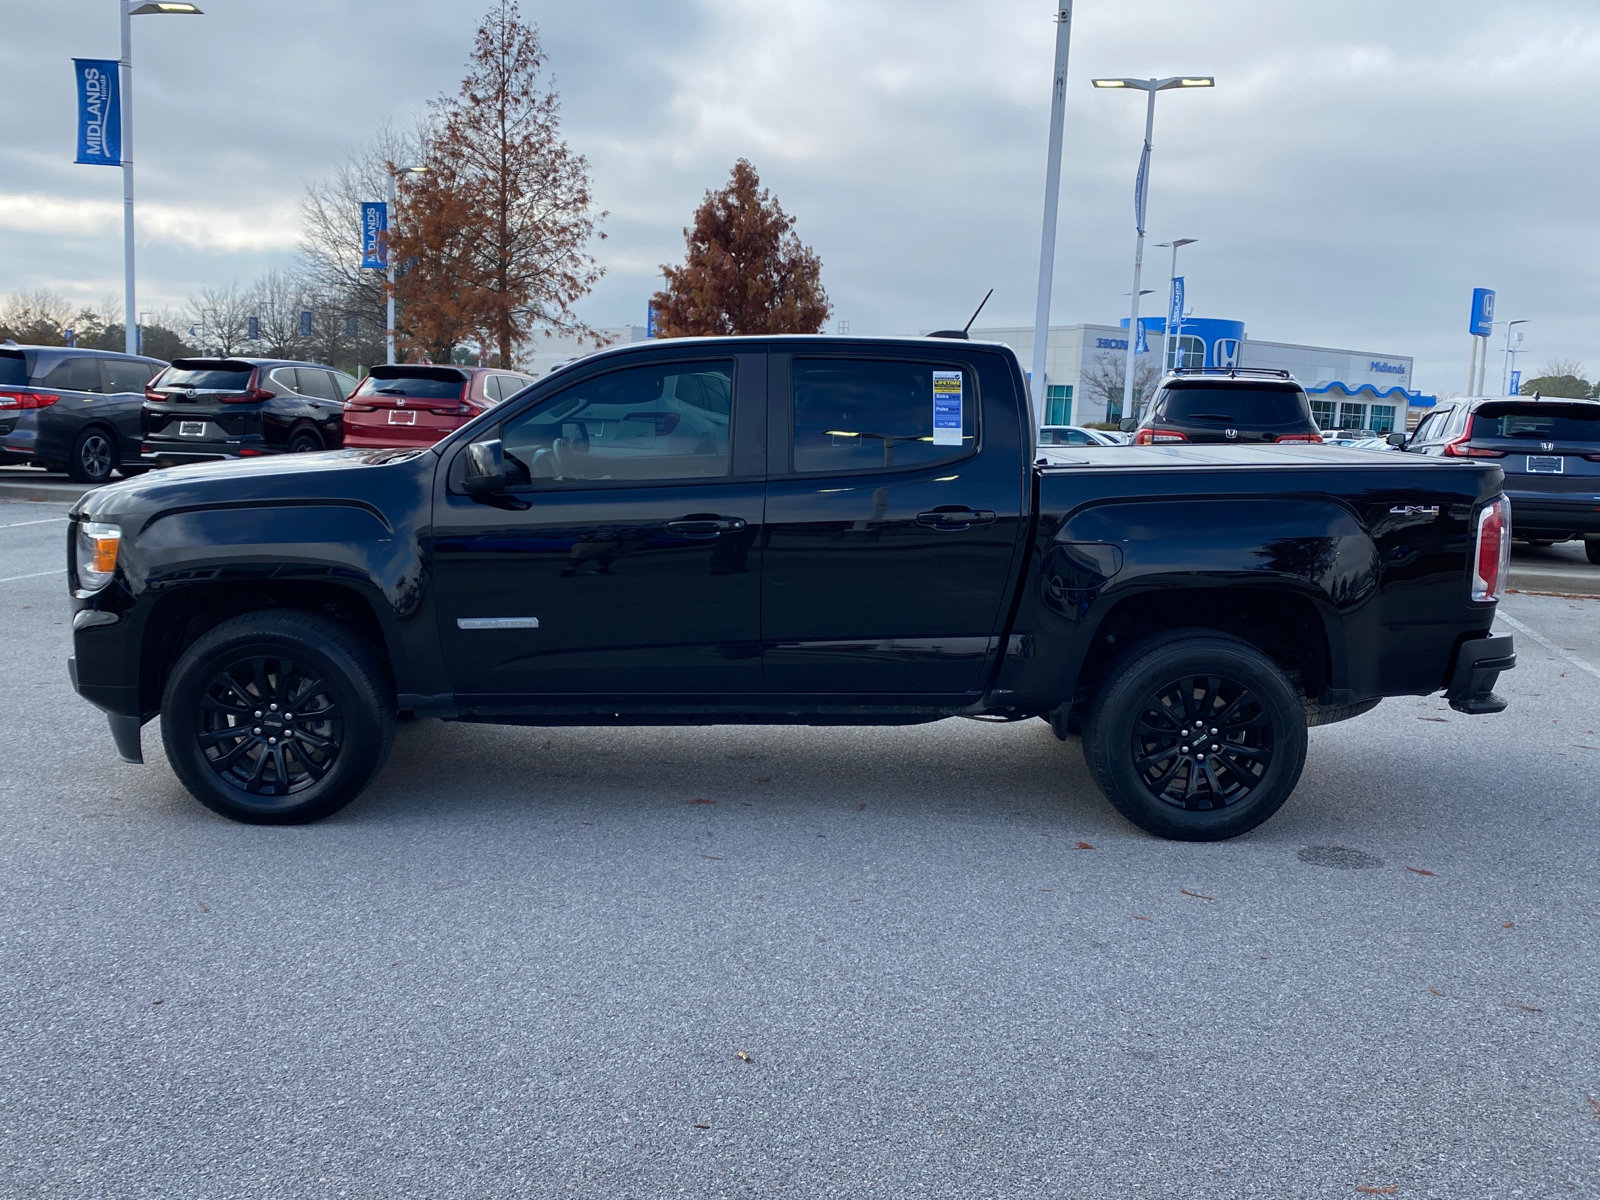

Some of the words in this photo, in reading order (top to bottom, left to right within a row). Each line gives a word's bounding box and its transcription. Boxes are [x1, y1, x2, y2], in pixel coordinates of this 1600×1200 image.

[84, 68, 102, 154] MIDLANDS
[366, 207, 376, 262] MDLANDS
[1172, 281, 1180, 322] MIDLANDS
[1096, 338, 1149, 352] HONA
[1370, 361, 1406, 374] Midlands
[463, 620, 533, 628] ELEVATION
